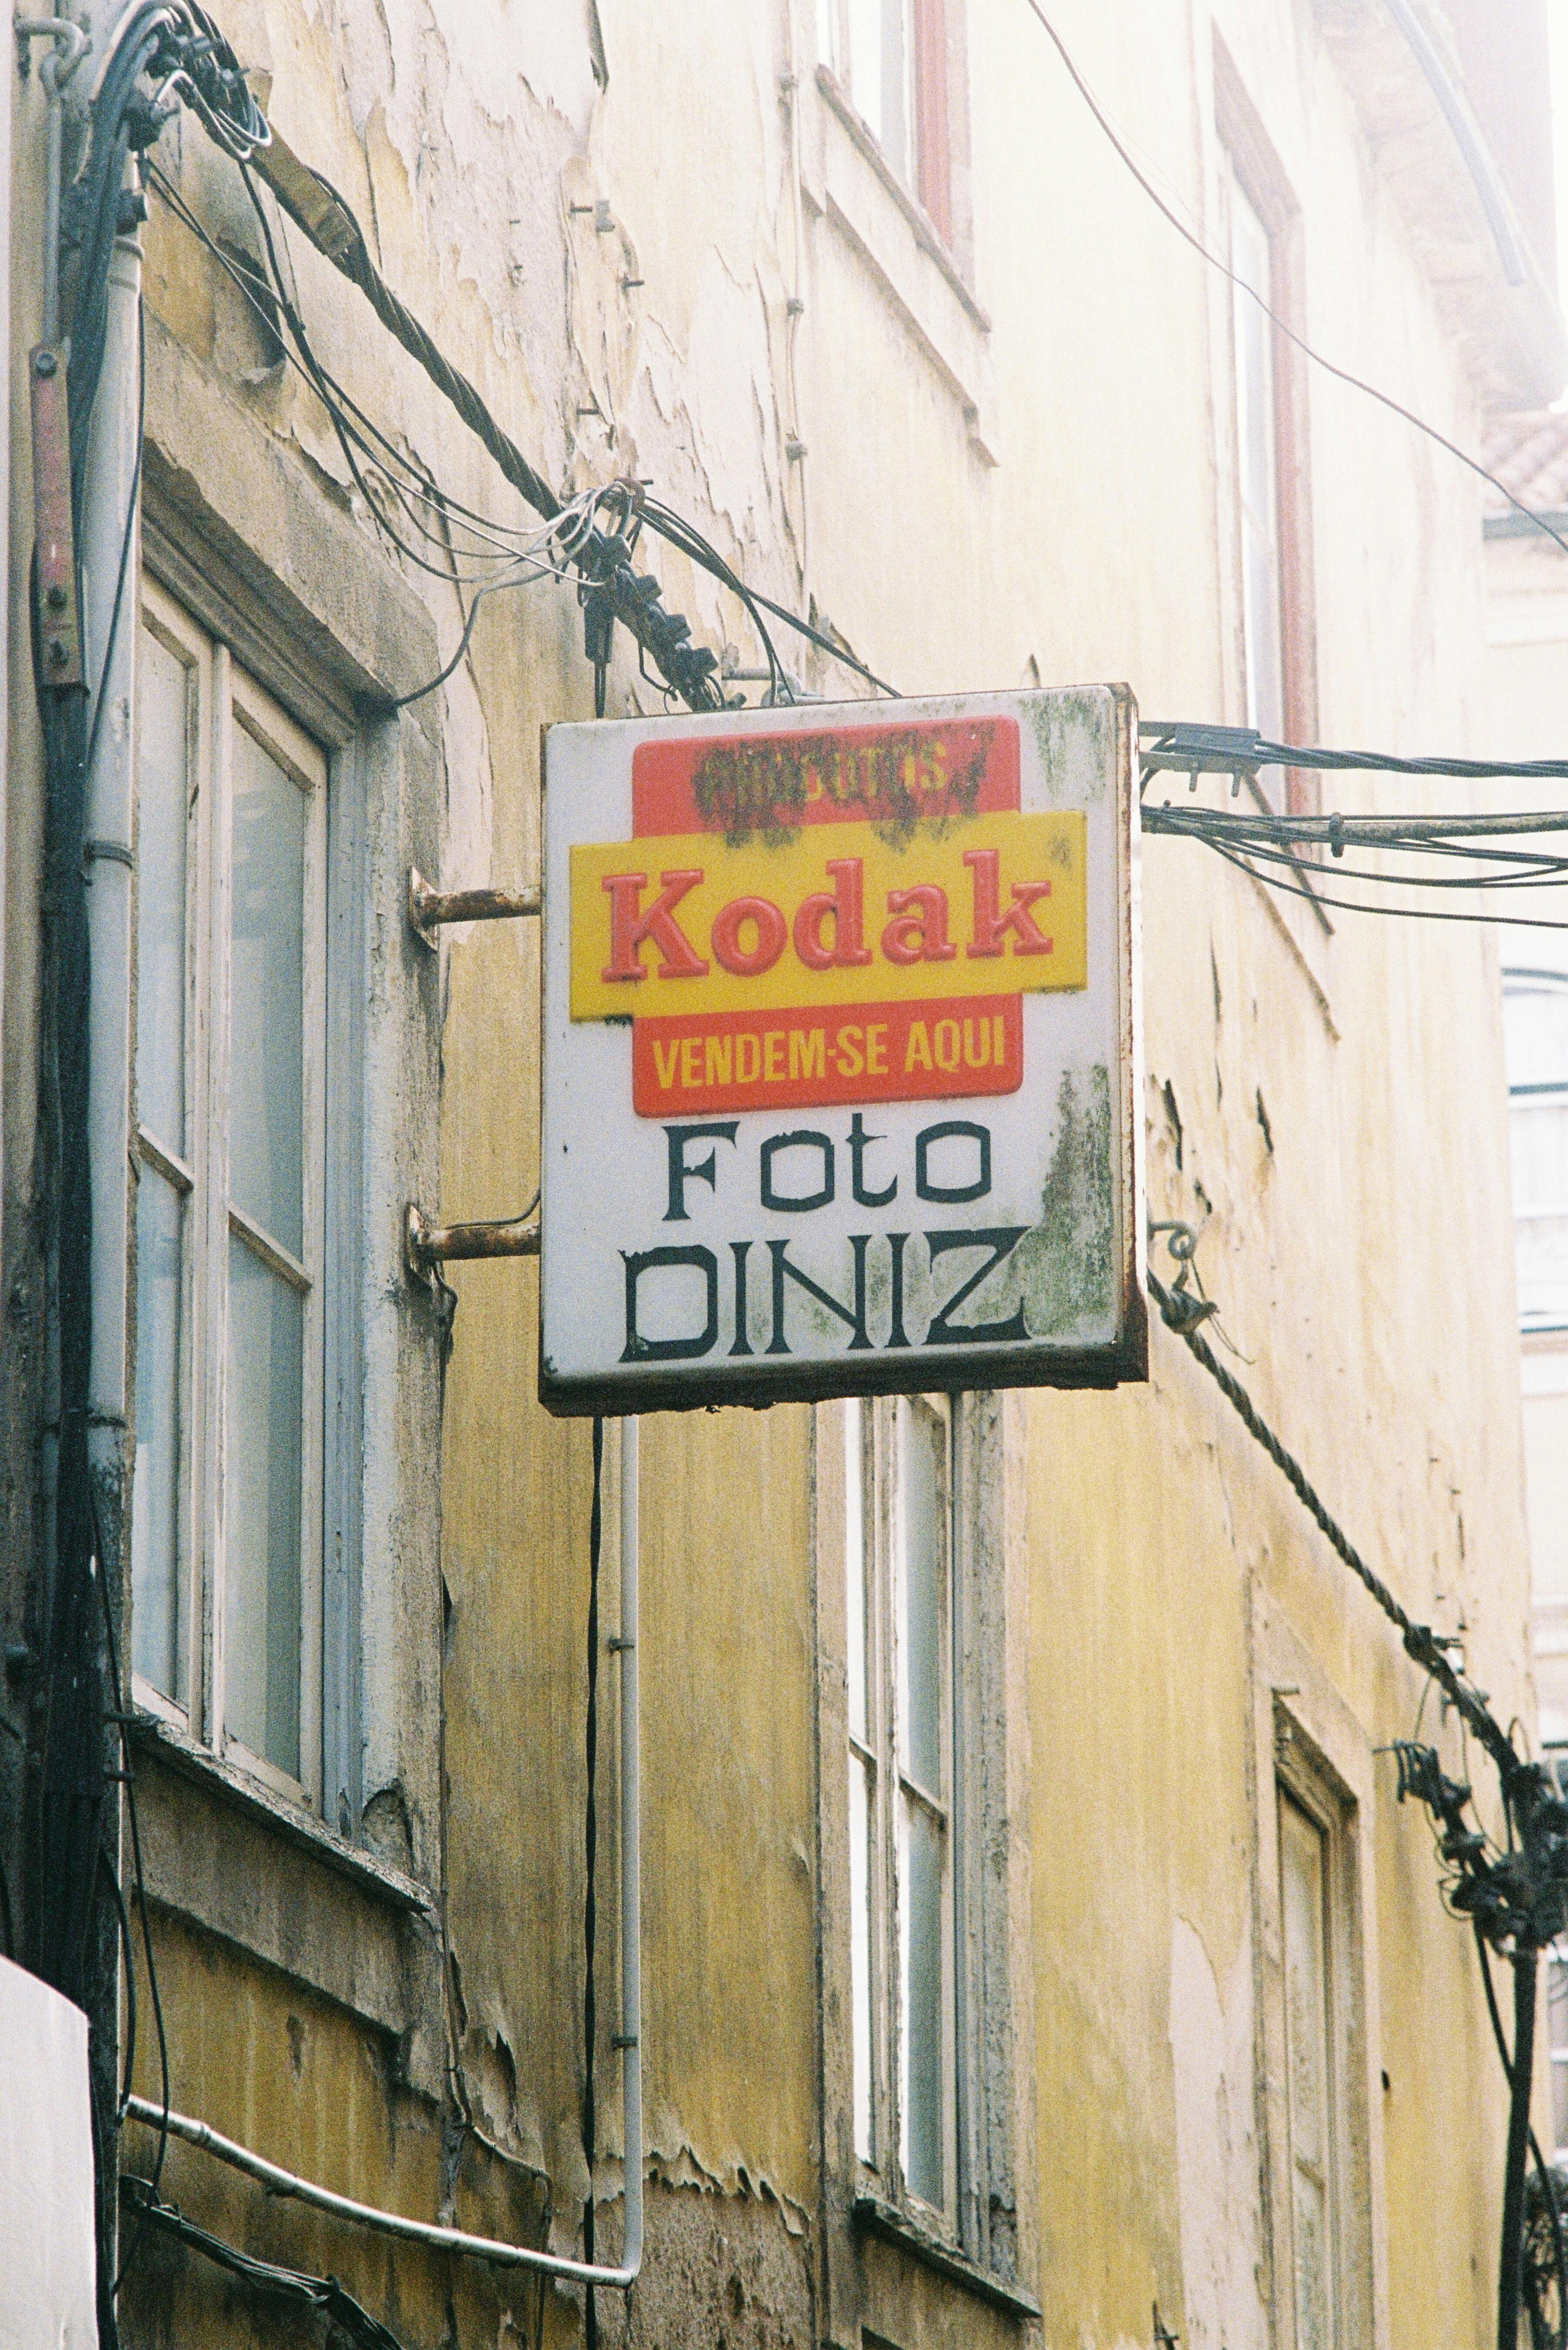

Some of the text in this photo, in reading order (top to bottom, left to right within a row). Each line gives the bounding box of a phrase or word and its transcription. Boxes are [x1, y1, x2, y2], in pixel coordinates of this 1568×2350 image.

[601, 849, 1053, 983] Kodak
[652, 1015, 1005, 1089] VENDEM-SE AQUI
[662, 1113, 992, 1221] Foto
[618, 1226, 1034, 1362] DINIZ
